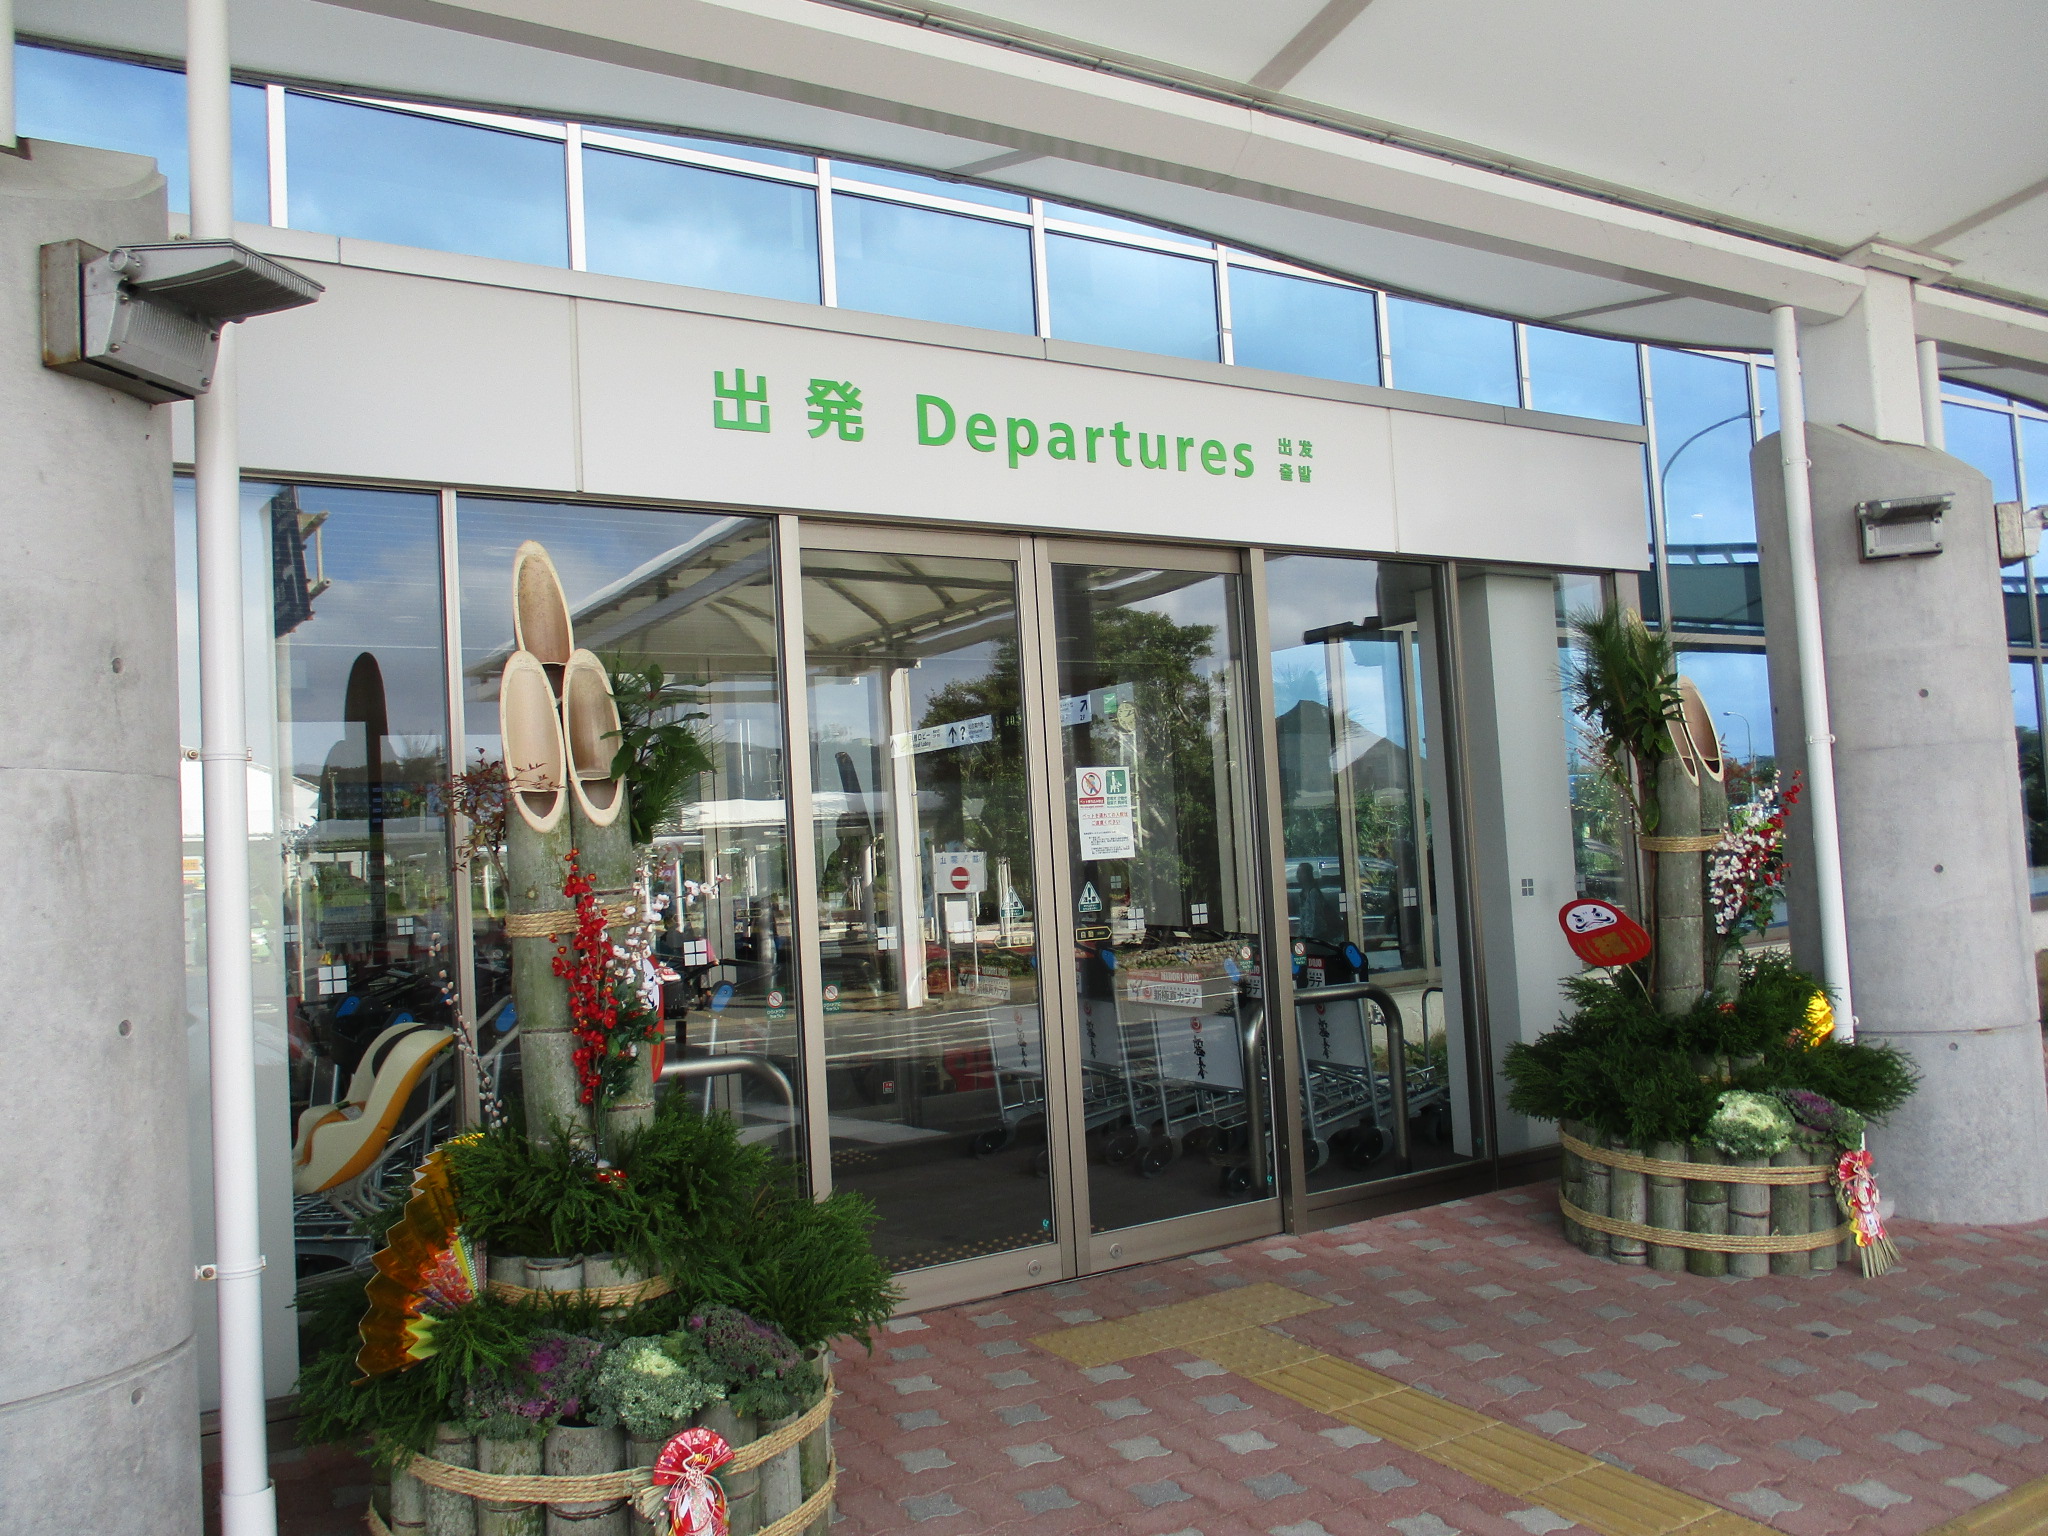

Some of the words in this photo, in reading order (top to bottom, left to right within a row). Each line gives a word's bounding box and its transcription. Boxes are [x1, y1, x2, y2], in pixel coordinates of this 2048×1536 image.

[713, 368, 865, 442] 出発
[915, 393, 1256, 479] Departures
[1278, 438, 1313, 458] 出发
[1279, 463, 1312, 483] 출발
